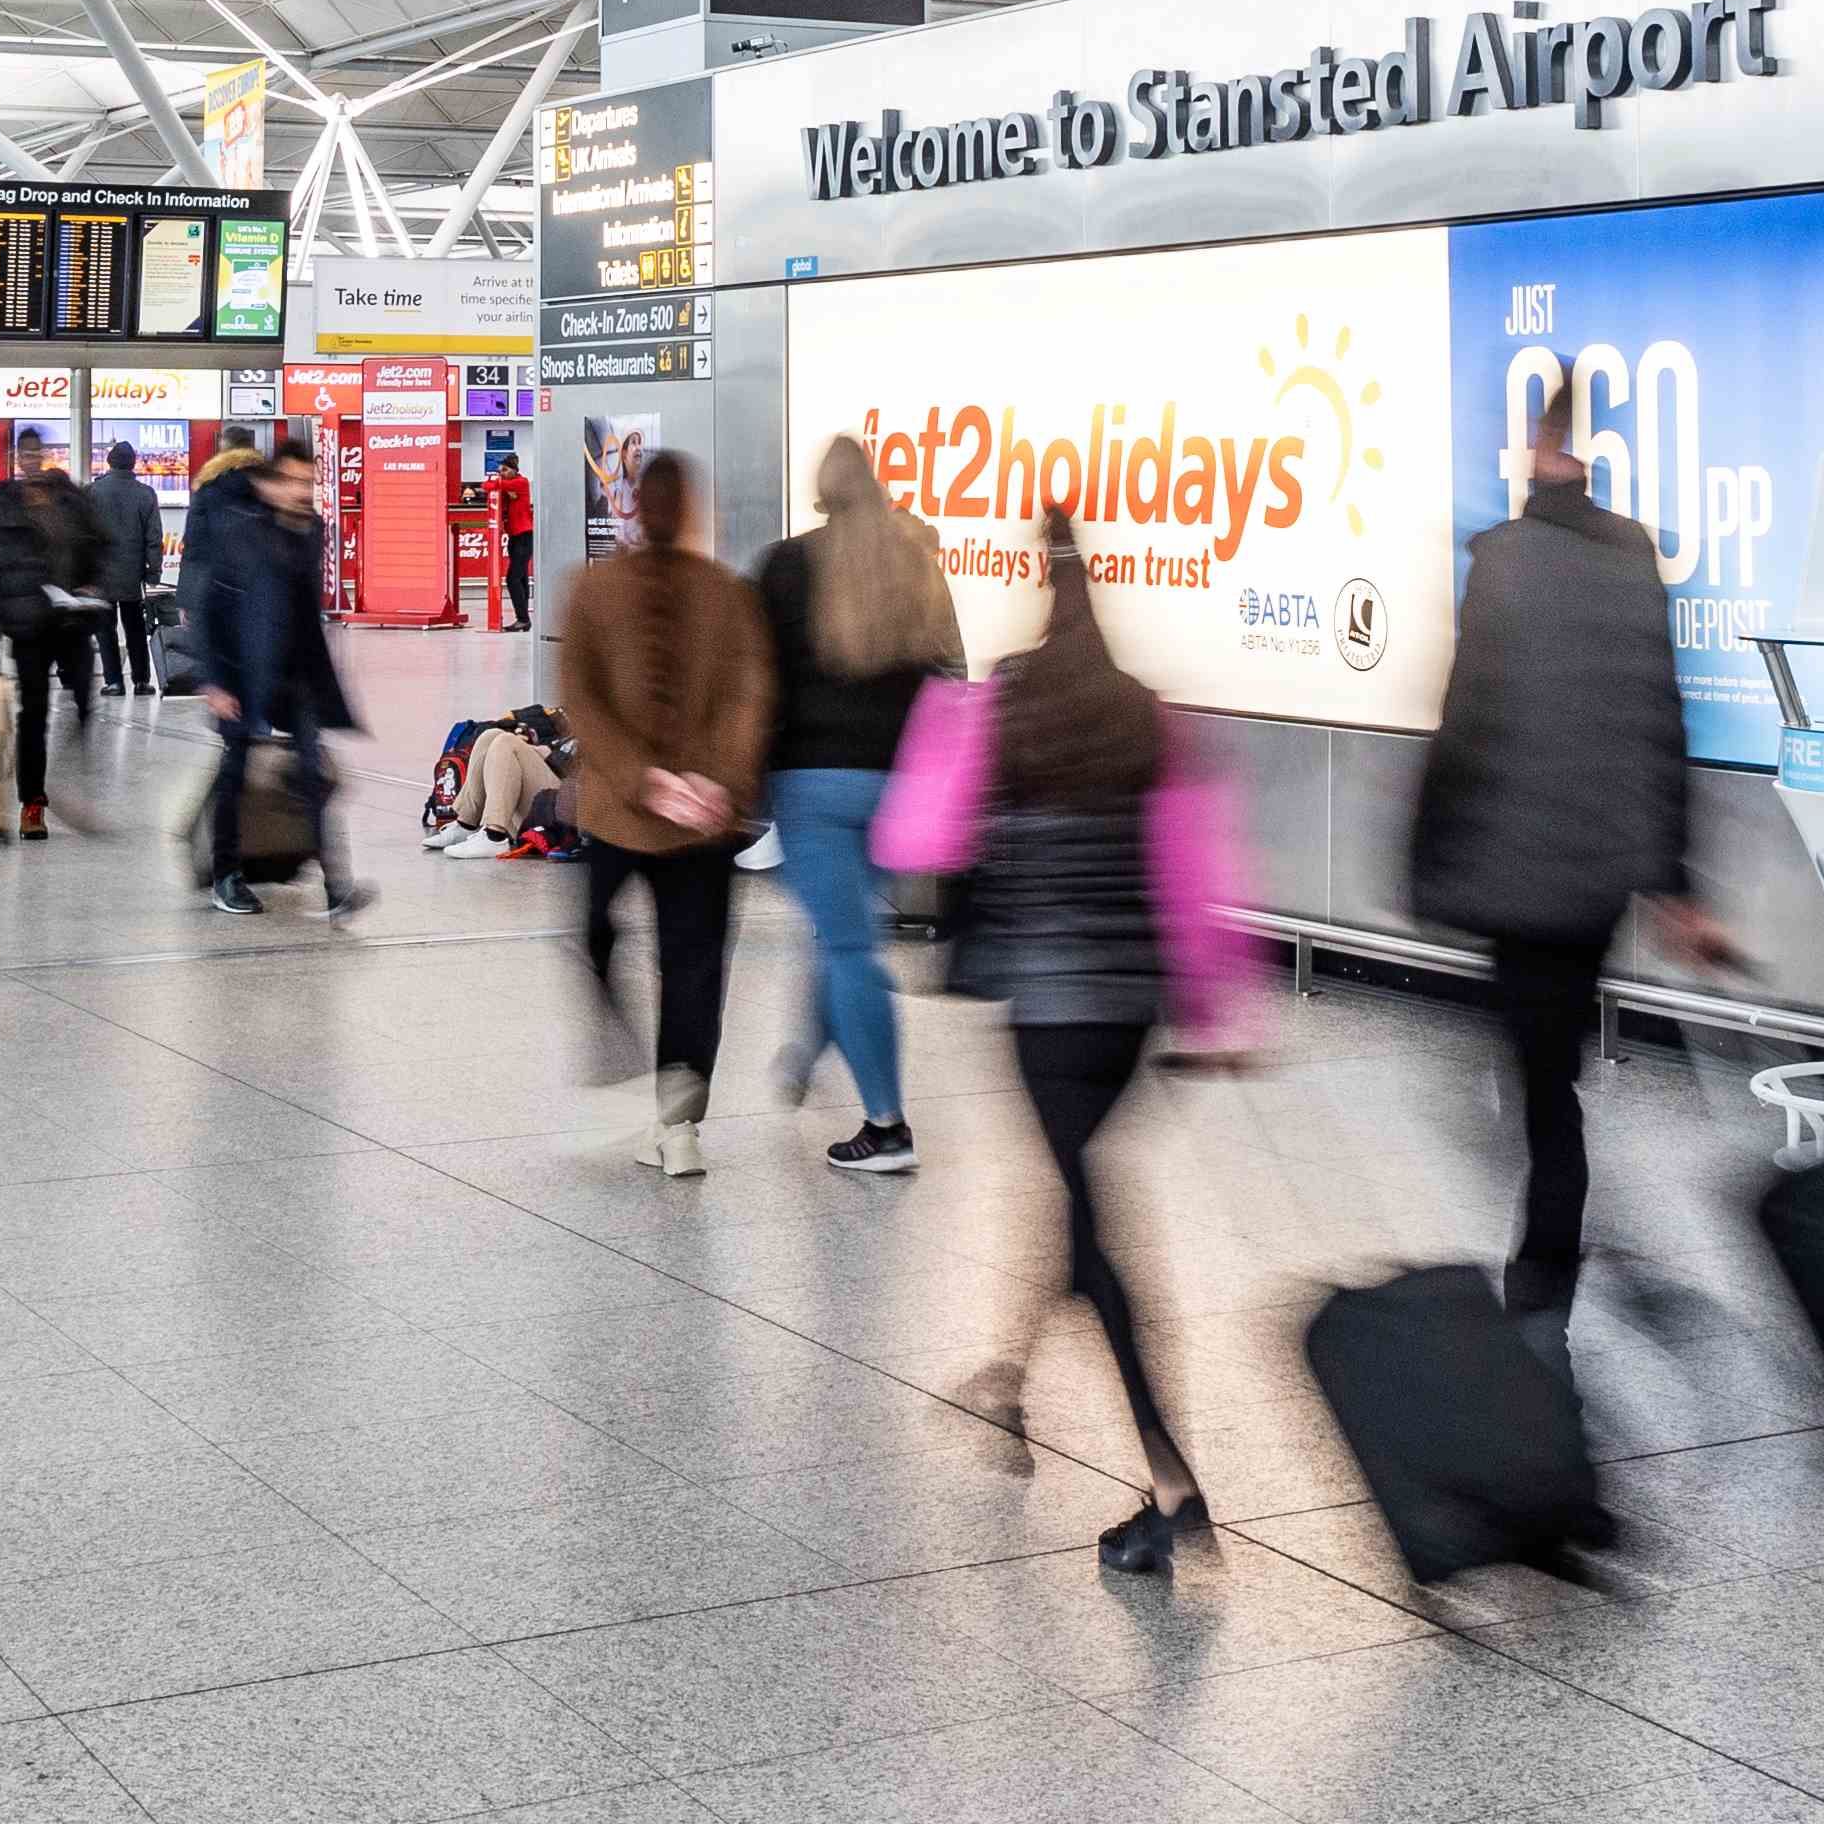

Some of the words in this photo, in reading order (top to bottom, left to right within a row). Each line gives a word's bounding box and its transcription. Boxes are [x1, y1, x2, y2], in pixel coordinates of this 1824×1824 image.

[800, 108, 1036, 200] Welcome
[1047, 89, 1119, 169] to
[1127, 16, 1434, 161] Stansted
[571, 105, 638, 138] Departures
[592, 140, 637, 171] Arrivals
[20, 187, 58, 205] Drop
[62, 188, 91, 203] and
[95, 189, 144, 205] Check
[147, 192, 161, 206] In
[165, 192, 250, 209] Information
[553, 180, 625, 216] International
[626, 174, 674, 206] Arrivals
[226, 232, 268, 244] Vitamin
[270, 232, 279, 244] D
[603, 216, 674, 248] Information
[598, 260, 639, 290] Toilets
[792, 258, 812, 276] global
[472, 276, 508, 289] Arrive
[511, 277, 523, 289] at
[335, 287, 378, 306] Take
[384, 288, 423, 307] time
[460, 293, 486, 305] time
[489, 293, 533, 308] specifie
[1505, 283, 1556, 336] JUST
[476, 313, 503, 325] your
[506, 312, 534, 323] airlin
[561, 310, 613, 337] Check-In
[616, 308, 647, 333] Zone
[649, 304, 673, 331] 500
[287, 369, 362, 385] Jet2.com
[376, 366, 433, 378] Jet2.com
[476, 365, 501, 385] 34
[541, 354, 575, 383] Shops
[577, 354, 585, 377] &
[587, 352, 655, 377] Restaurants
[6, 376, 168, 404] Jet2olidays
[366, 402, 434, 418] Jet2holidays
[140, 424, 185, 448] MALTA
[368, 435, 414, 450] Check-in
[415, 435, 441, 448] open
[1088, 553, 1135, 584] can
[1145, 547, 1212, 589] trust
[1262, 593, 1320, 629] ABTA
[1676, 596, 1773, 653] DEPOSIT
